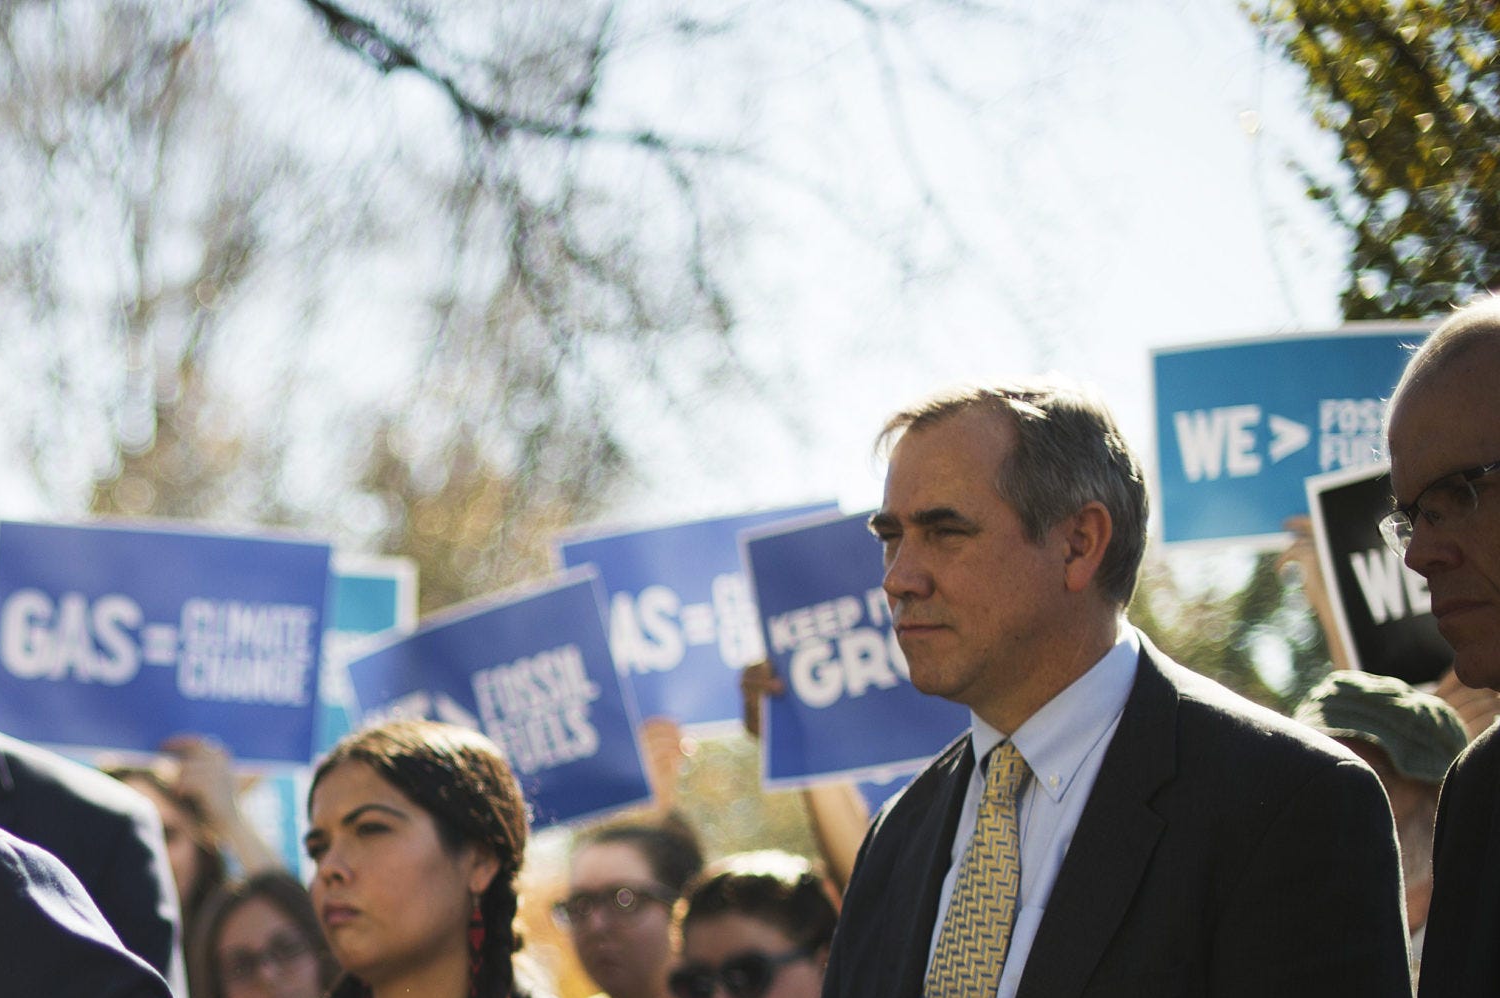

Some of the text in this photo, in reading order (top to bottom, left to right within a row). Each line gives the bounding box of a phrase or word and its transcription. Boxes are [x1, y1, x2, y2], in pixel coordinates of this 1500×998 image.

[1173, 404, 1262, 483] WE
[2, 588, 144, 686] GAS
[180, 599, 317, 657] CLIMATE
[769, 597, 862, 654] KEEP
[177, 650, 311, 707] CHANGE
[471, 643, 601, 728] FOSSIL
